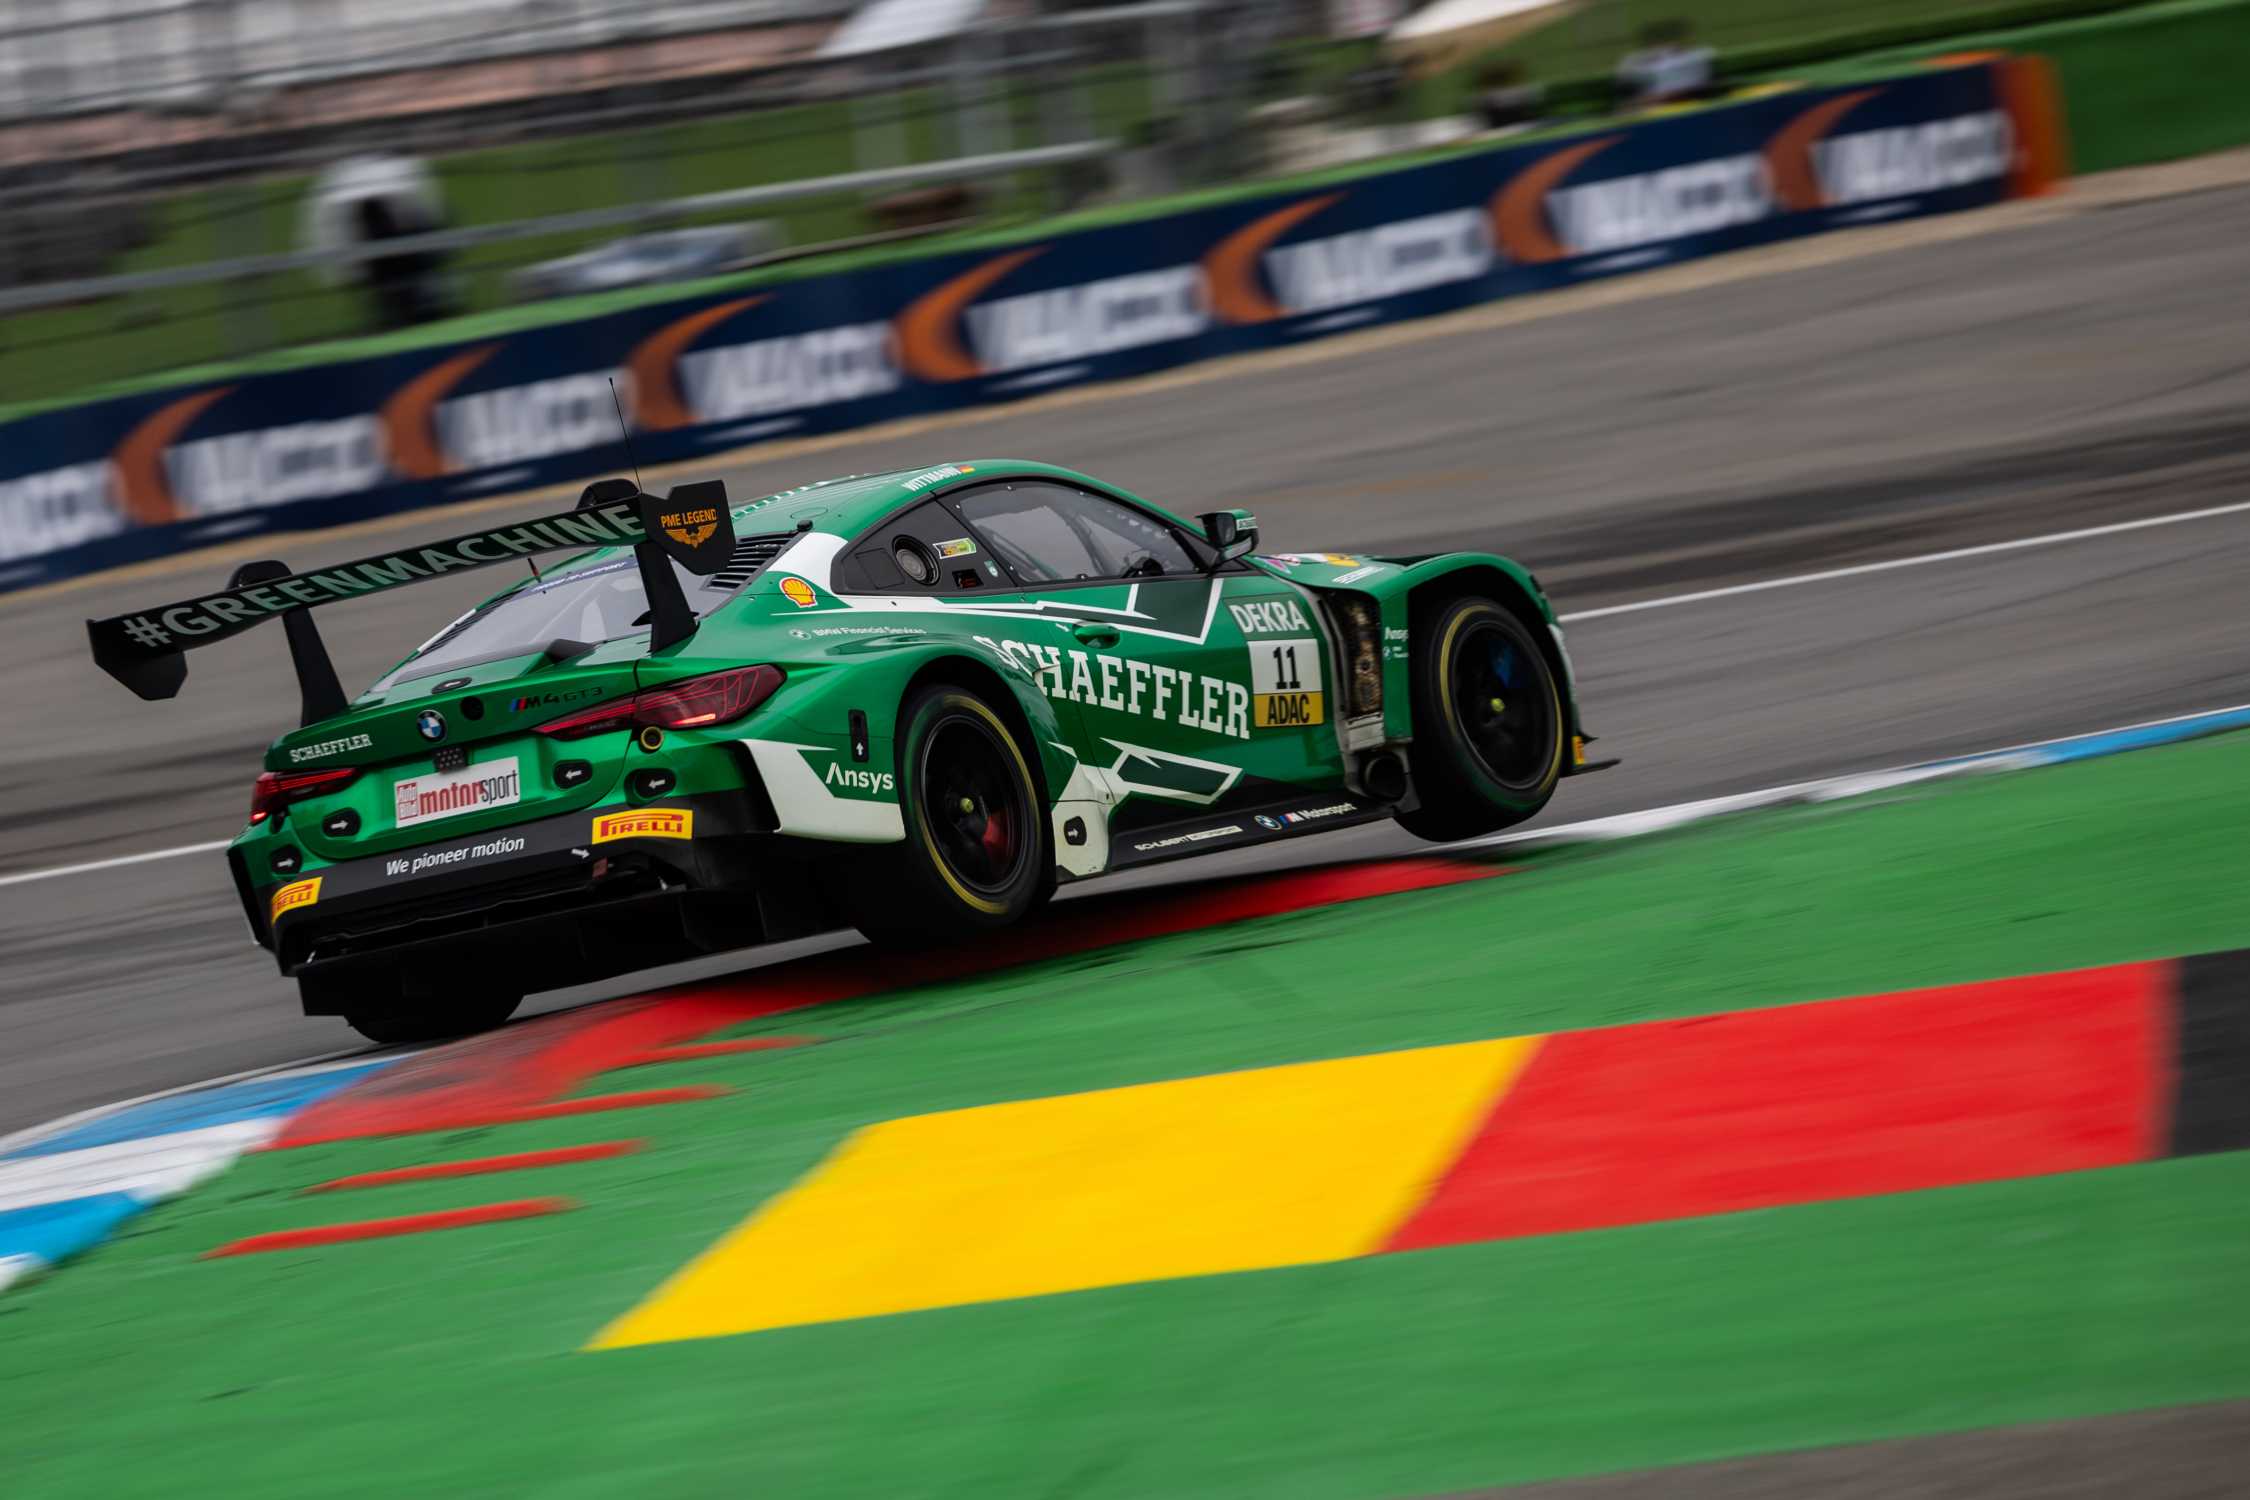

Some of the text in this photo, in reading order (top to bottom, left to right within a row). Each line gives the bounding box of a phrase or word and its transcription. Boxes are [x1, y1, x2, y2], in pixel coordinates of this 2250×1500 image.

[660, 508, 718, 528] PME LEGEND
[124, 504, 646, 648] #GREENMACHINE
[1229, 600, 1311, 633] DEKRA
[1272, 646, 1301, 689] 11
[972, 635, 1251, 740] SCHAEFFLER
[1267, 694, 1311, 725] ADAC
[290, 733, 373, 763] SCHAEFFLER
[420, 769, 519, 816] motorsport
[825, 761, 894, 795] Ansys
[600, 813, 684, 837] PIRELLI
[386, 837, 525, 876] We pioneer motion
